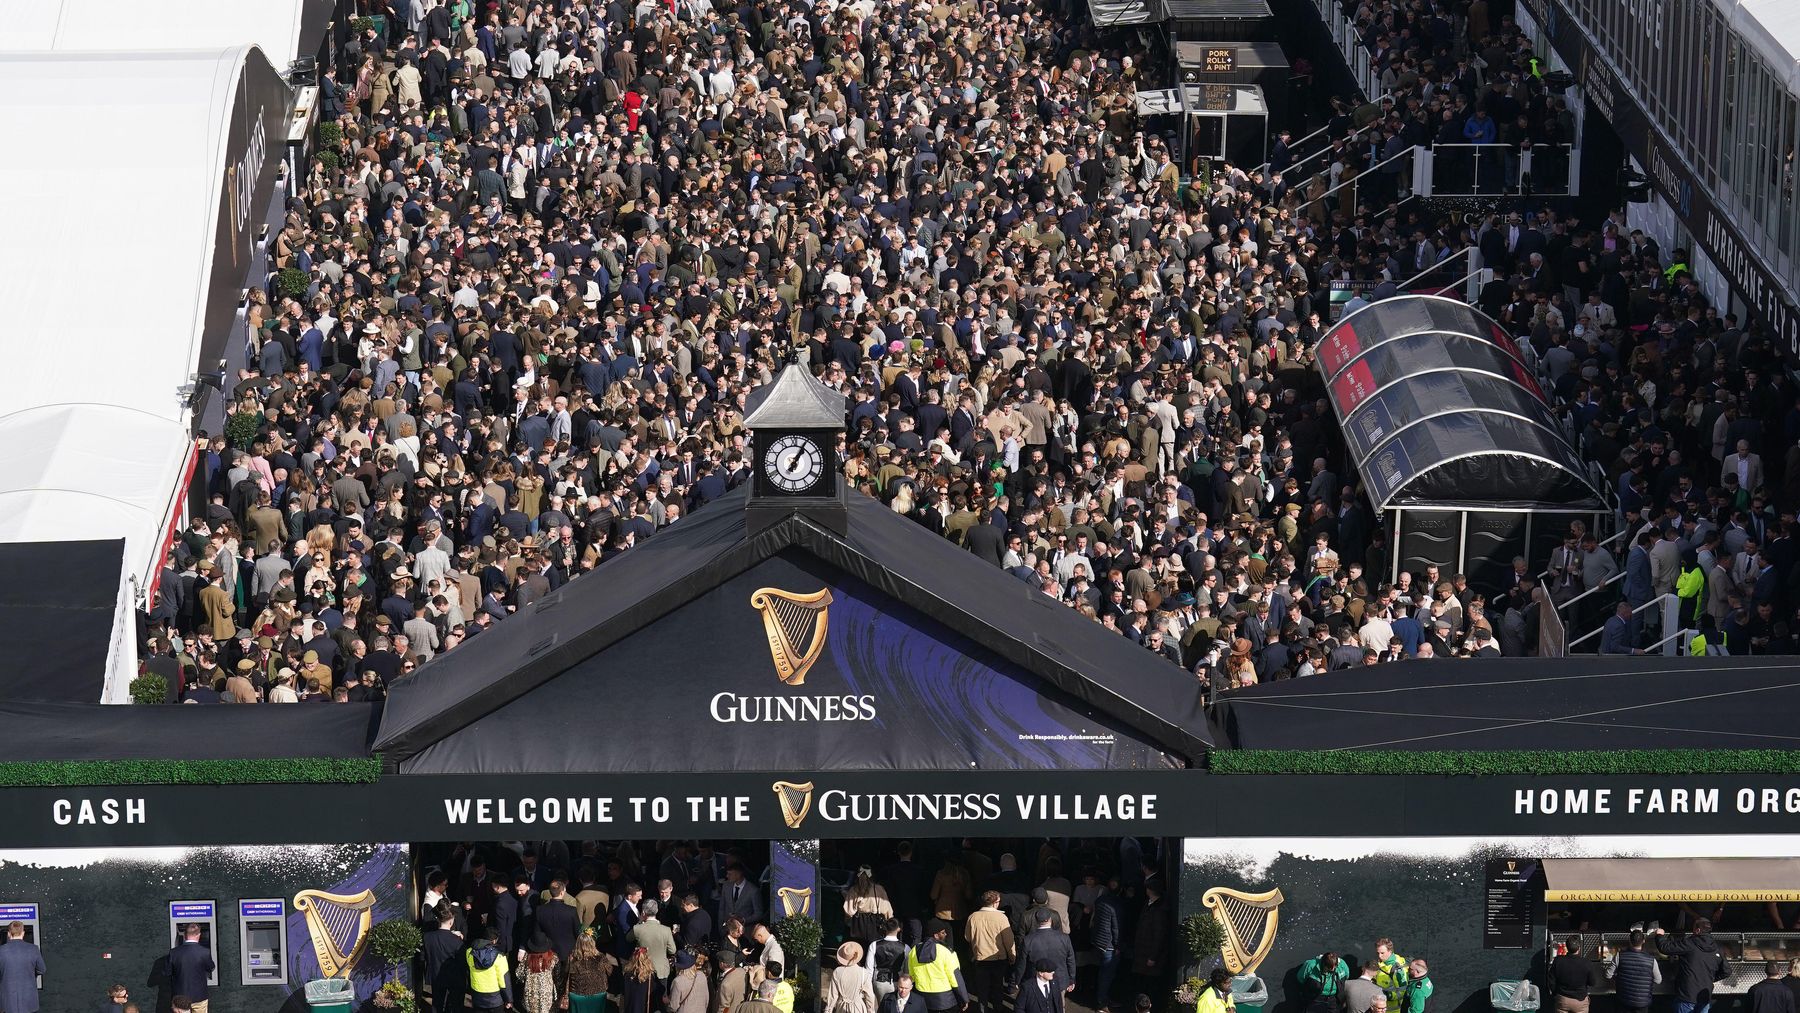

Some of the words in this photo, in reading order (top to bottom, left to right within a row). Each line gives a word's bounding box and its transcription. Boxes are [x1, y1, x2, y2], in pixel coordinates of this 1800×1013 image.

[236, 105, 266, 232] GUINNESS
[1652, 145, 1680, 203] GUINNESS
[1706, 210, 1764, 312] HURRICANE
[1767, 289, 1786, 340] FLY
[1414, 520, 1448, 529] ARENA
[1480, 520, 1513, 529] ARENA
[776, 650, 789, 673] 1759
[710, 692, 876, 722] GUINNESS
[53, 798, 146, 826] CASH
[445, 798, 612, 824] WELCOME
[629, 797, 669, 822] TO
[687, 796, 750, 822] THE
[818, 789, 1001, 821] GUINNESS
[1016, 793, 1157, 820] VILLAGE
[1514, 789, 1611, 815] HOME
[1627, 788, 1719, 814] FARM
[1736, 787, 1800, 814] ORG
[1560, 893, 1613, 901] ORGANIC
[1620, 893, 1652, 901] MEAT
[1656, 893, 1713, 901] SOURCED
[1717, 893, 1750, 901] FROM
[1755, 893, 1793, 901] HOME
[320, 951, 333, 971] 1759
[1225, 948, 1238, 969] 1759
